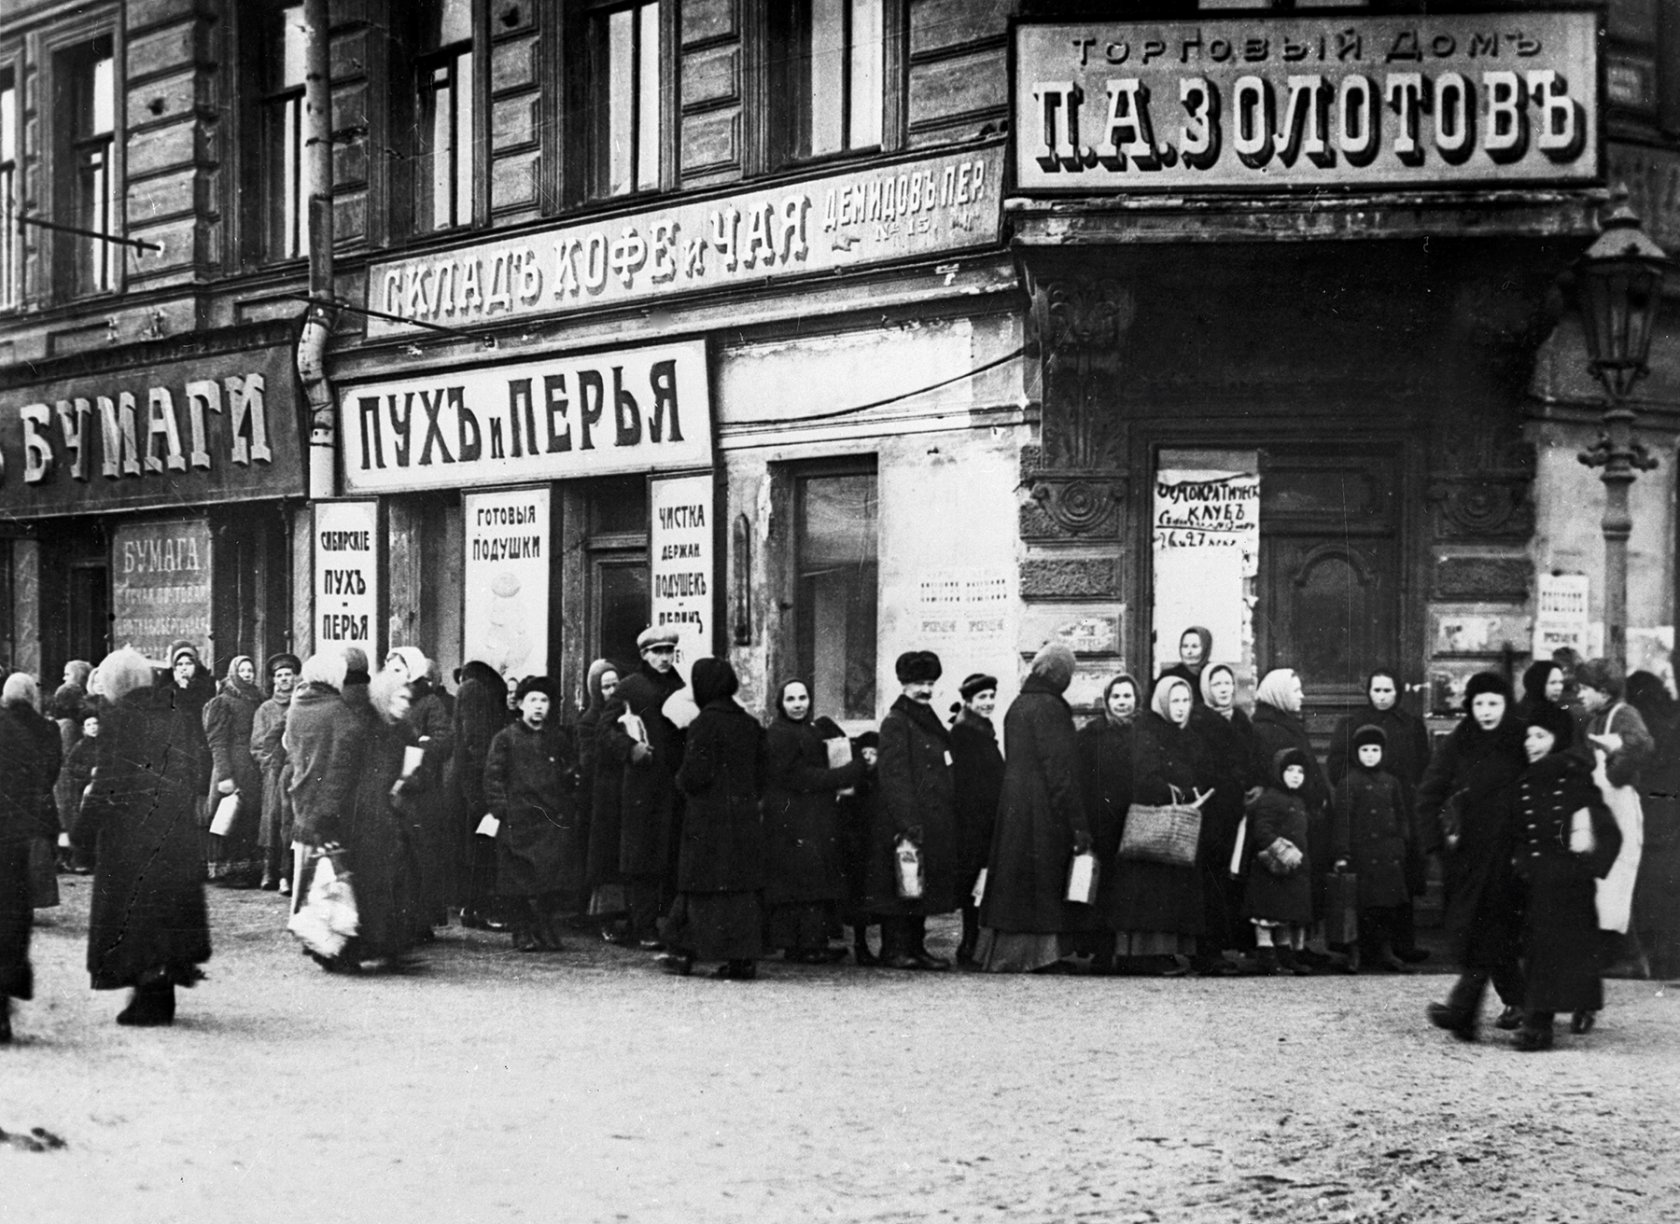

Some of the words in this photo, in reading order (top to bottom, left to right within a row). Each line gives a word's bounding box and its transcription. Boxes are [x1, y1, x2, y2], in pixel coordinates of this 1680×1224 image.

[1072, 29, 1363, 65] ТОРГОВЫЙ
[1386, 29, 1542, 63] ДОМЪ
[824, 170, 936, 233] ДЕМИДОВЪ
[383, 246, 543, 321] СКЛАДЪ
[553, 218, 681, 301] КОФЕ
[710, 195, 812, 272] ЧАЯ
[20, 373, 271, 482] БУМАГИ
[357, 386, 482, 470] ПУХЪ
[508, 359, 684, 458] ПЕРЬЯ
[477, 505, 536, 527] ГОТОВЫЯ
[659, 504, 705, 529] ЧИСТКА
[123, 537, 201, 574] БУМАГА
[473, 535, 540, 562] ПОДУШКИ
[324, 569, 366, 595] ПУХЪ
[655, 572, 707, 599] ПОДУШЕКЪ
[323, 614, 368, 640] ПЕРЬЯ
